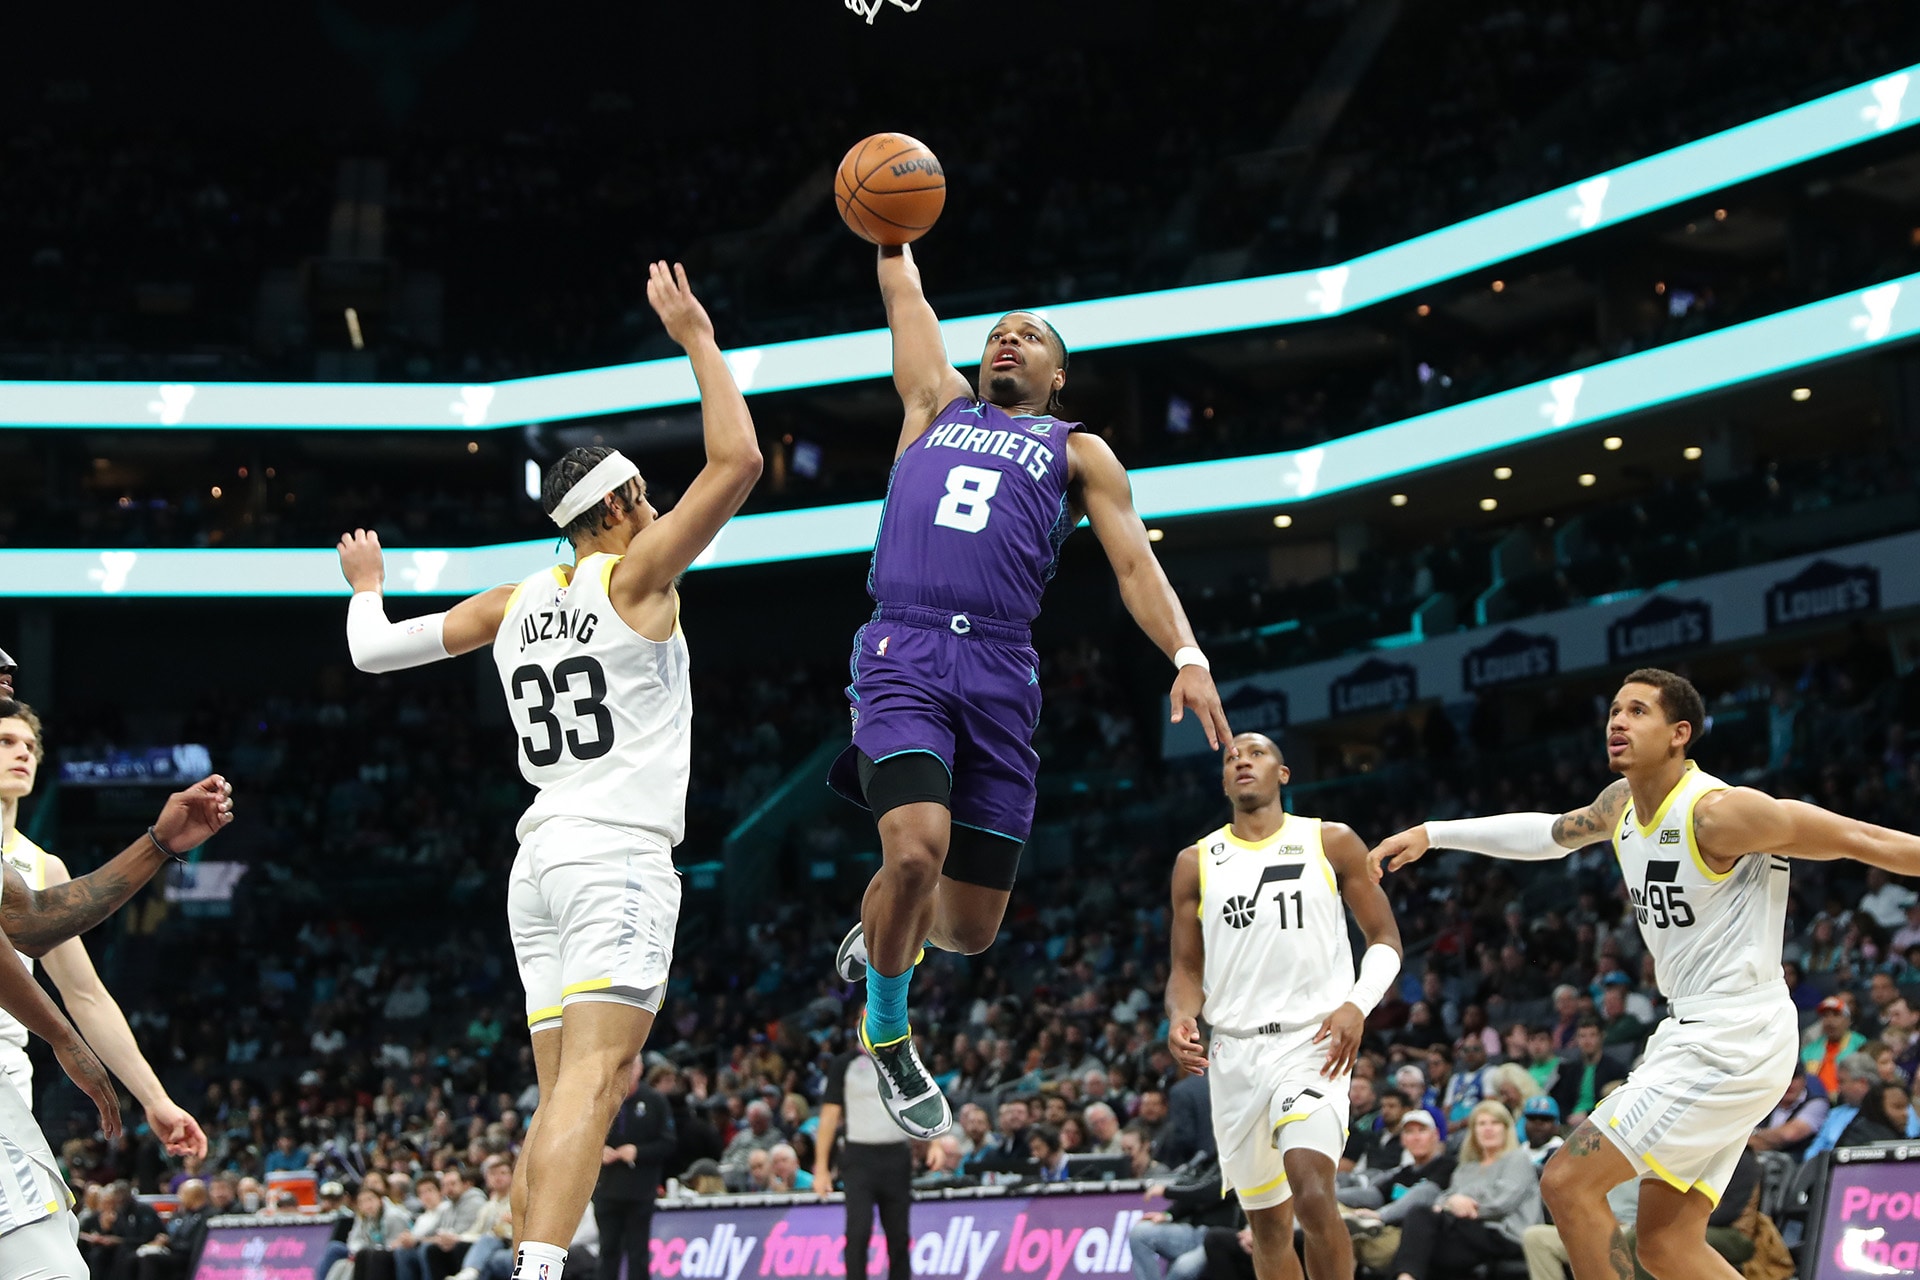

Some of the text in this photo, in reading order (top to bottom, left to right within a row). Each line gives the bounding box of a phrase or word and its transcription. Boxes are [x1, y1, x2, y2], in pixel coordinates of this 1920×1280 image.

[923, 423, 1055, 483] HORNETS
[933, 464, 1003, 535] 8
[1776, 577, 1871, 624] LOWE'S
[519, 608, 599, 653] JUZANG
[1616, 618, 1704, 657] LOWE'S
[512, 656, 614, 767] 33
[1273, 891, 1303, 929] 11
[1649, 885, 1695, 929] 95
